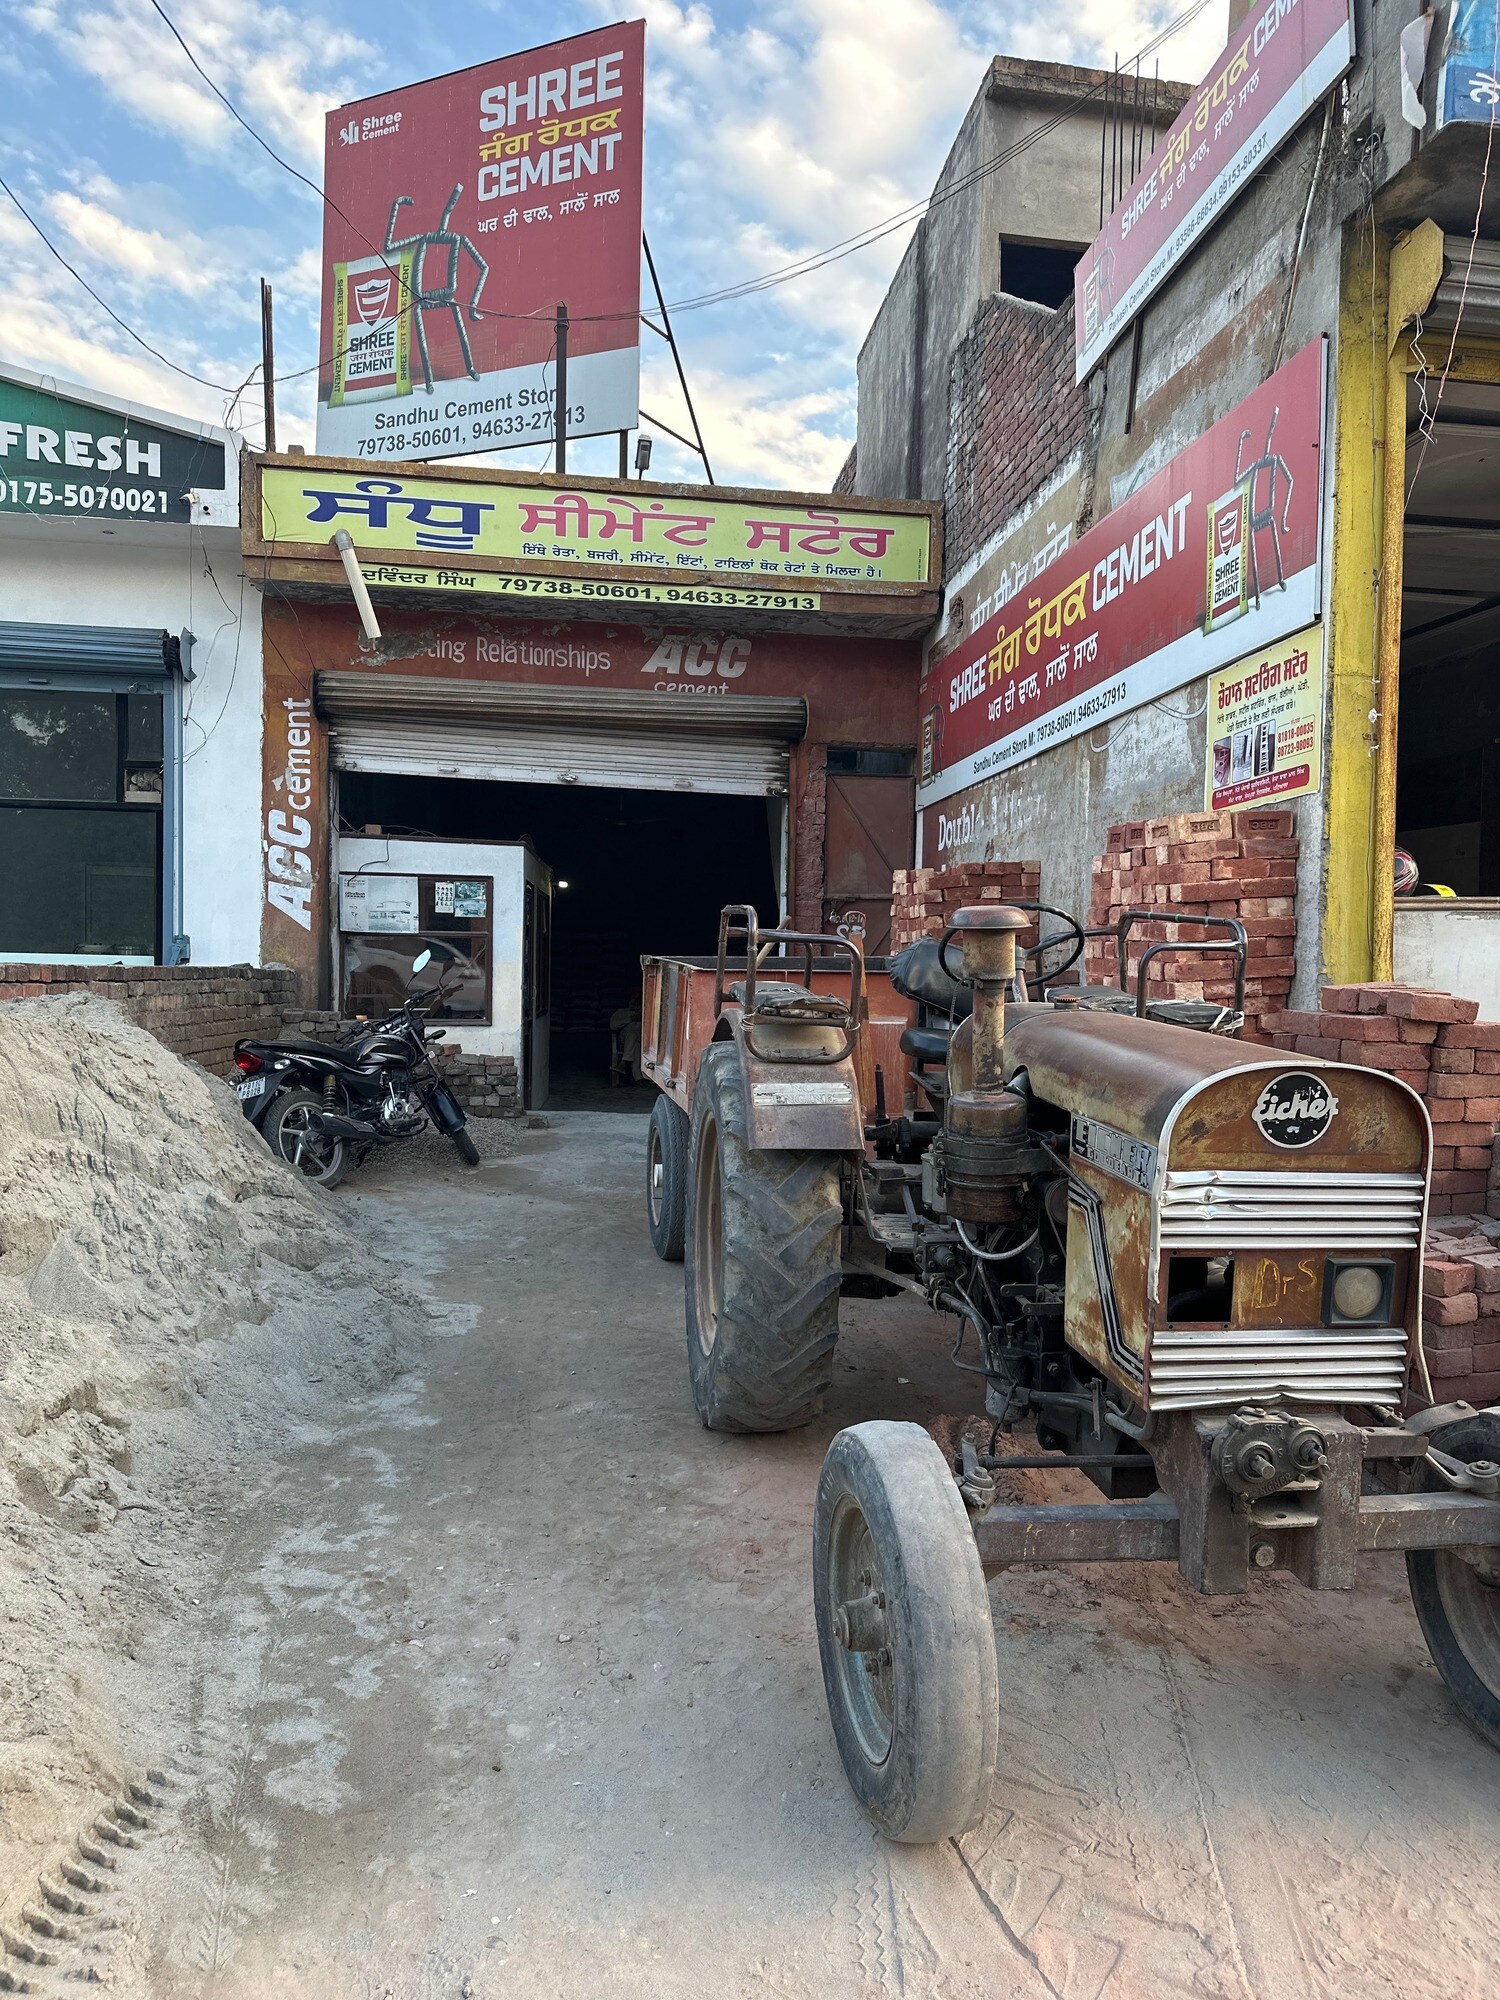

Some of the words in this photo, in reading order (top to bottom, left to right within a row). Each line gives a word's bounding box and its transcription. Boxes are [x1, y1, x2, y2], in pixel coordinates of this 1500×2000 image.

[479, 50, 624, 132] SHREE
[362, 112, 402, 131] Shree
[362, 123, 400, 141] Cement
[478, 132, 534, 162] ਜੰਗ
[537, 108, 622, 144] ਰੋਧਕ
[1121, 168, 1158, 240] SHREE
[1158, 133, 1194, 187] ਜੰਗ
[1194, 34, 1252, 132] ਰੋਧਕ
[1253, 0, 1298, 57] CEM
[1160, 183, 1174, 211] ਘਰ
[1176, 162, 1187, 190] ਦੀ
[1214, 95, 1236, 140] ਸਾਲੋਂ
[1239, 68, 1260, 108] ਸਾਲ
[477, 132, 622, 202] CEMENT
[477, 217, 499, 233] ਘਰ
[503, 208, 519, 228] ਦੀ
[523, 205, 553, 224] ਢਾਲ,
[560, 192, 589, 215] ਸਾਲੋਂ
[593, 188, 620, 208] ਸਾਲ
[401, 264, 410, 298] CEMENT
[1129, 277, 1150, 308] Cement
[1150, 257, 1166, 283] Store
[350, 331, 395, 352] SHREE
[350, 350, 367, 362] जंग
[334, 360, 342, 392] CEMENT
[349, 357, 394, 375] CEMENT
[375, 407, 439, 430] Sandhu
[444, 392, 513, 419] Cement
[518, 388, 557, 407] Stor
[0, 420, 161, 478] FRESH
[358, 425, 466, 456] 79738-50601,
[302, 480, 496, 550] ਸੰਧੂ
[744, 510, 896, 559] ਸਟੋਰ
[586, 548, 624, 564] ਬਜਰੀ,
[676, 553, 708, 569] ਇੱਟਾਂ,
[714, 556, 754, 570] ਟਾਇਲਾਂ
[759, 558, 778, 572] ਥੋਕ
[784, 560, 806, 574] ਰੇਟਾਂ
[810, 562, 820, 574] ਤੇ
[825, 563, 862, 576] ਮਿਲਦਾ
[1215, 557, 1240, 582] SHREE
[436, 571, 476, 588] ਸਿੰਘ
[498, 577, 660, 602] 79738-50601,
[666, 588, 816, 610] 94633-27913
[949, 654, 987, 713] SHREE
[988, 625, 1023, 686] ਜੰਗ
[1025, 570, 1090, 655] ਰੋਧਕ
[1092, 490, 1192, 612] CEMENT
[1214, 580, 1240, 604] CEMENT
[476, 637, 611, 676] Relationships
[641, 634, 752, 678] ACC
[988, 696, 1002, 722] ਘਰ
[1004, 680, 1016, 713] ਦੀ
[1018, 672, 1041, 705] ਢਾਲ,
[1046, 642, 1070, 688] ਸਾਲੋਂ
[1074, 631, 1099, 670] ਸਾਲ
[1283, 648, 1308, 682] ਸਟੋਰ
[282, 697, 311, 812] cement
[973, 757, 992, 774] Sandhu
[992, 746, 1012, 766] Cement
[1012, 738, 1028, 756] Store
[1028, 732, 1036, 747] M:
[268, 809, 312, 932] ACC
[1251, 1088, 1339, 1123] Eicher
